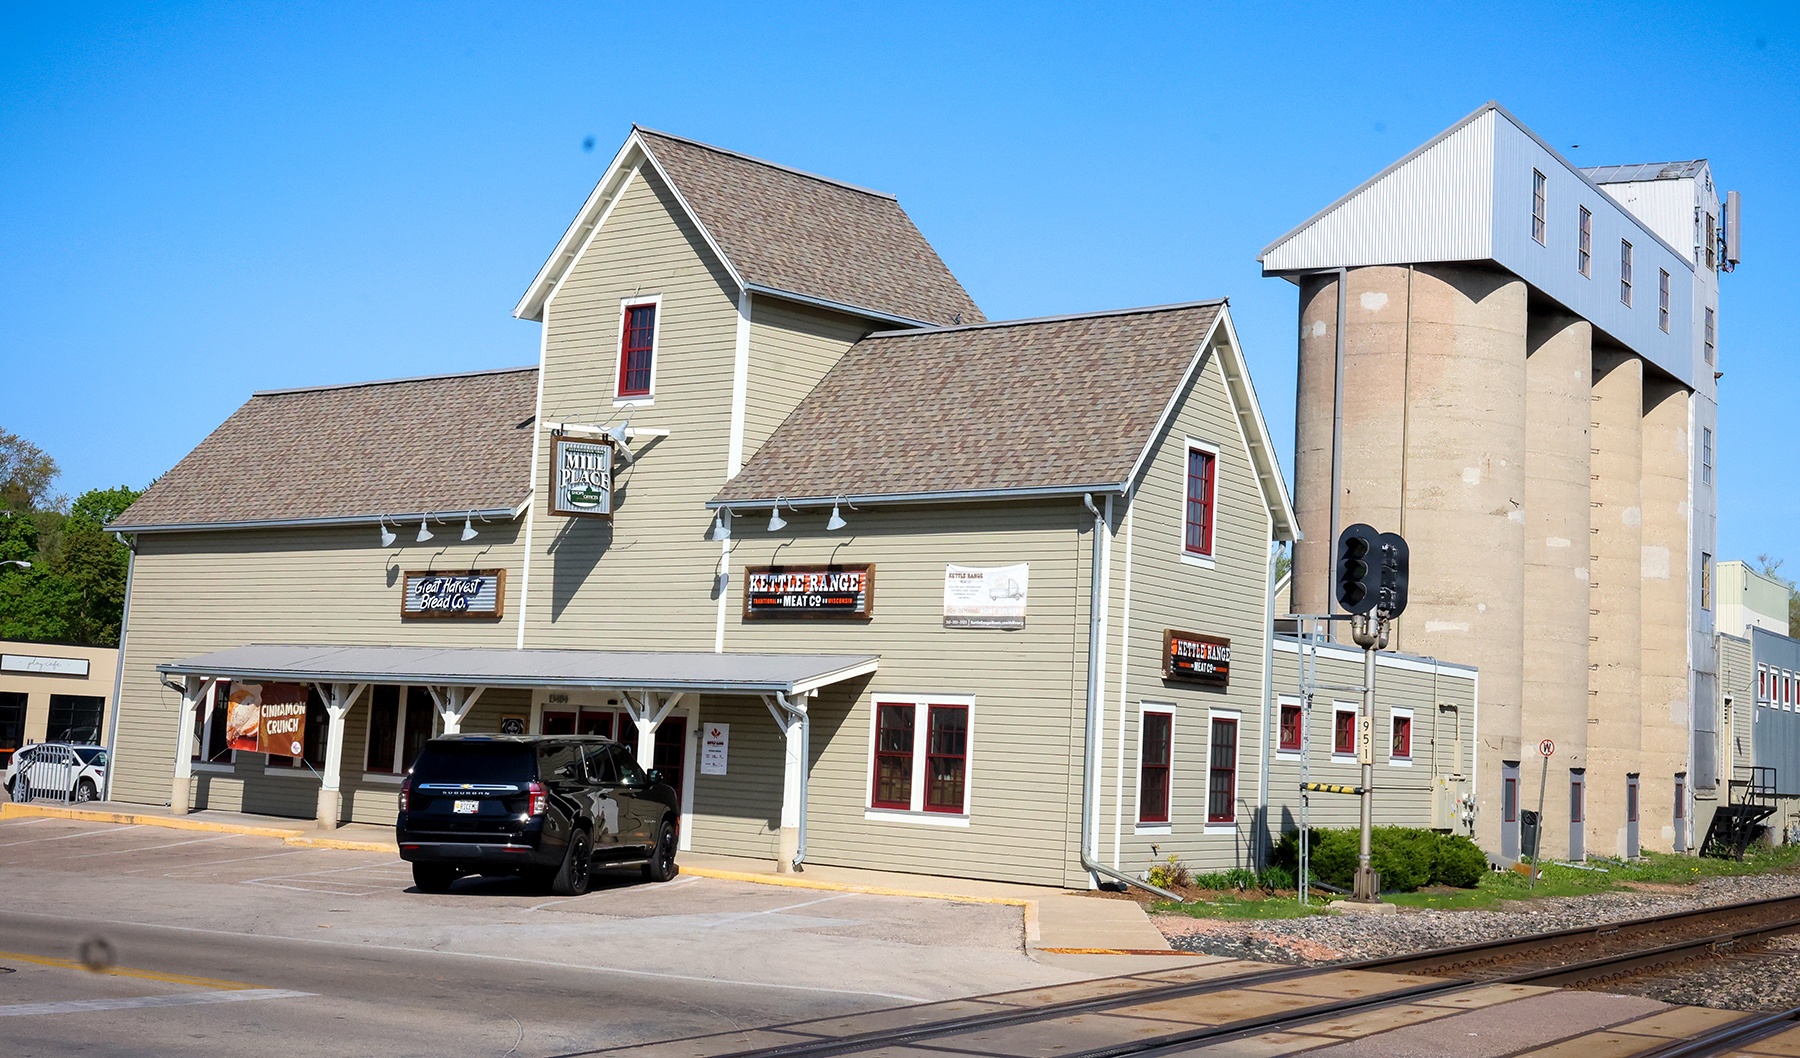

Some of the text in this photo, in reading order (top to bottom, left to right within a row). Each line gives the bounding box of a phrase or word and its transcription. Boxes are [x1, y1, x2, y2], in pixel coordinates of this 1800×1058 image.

[565, 454, 606, 471] MILL
[560, 469, 610, 491] PLACE
[414, 577, 481, 594] Great Harvest
[748, 573, 860, 592] KETTLE RANGE
[420, 593, 466, 609] Bread Co.
[783, 595, 808, 607] MEAT
[1177, 640, 1230, 662] KETTLE RANGE
[1193, 661, 1207, 673] MEAT
[261, 702, 306, 718] CINNAMON
[266, 718, 299, 735] CRUNCH
